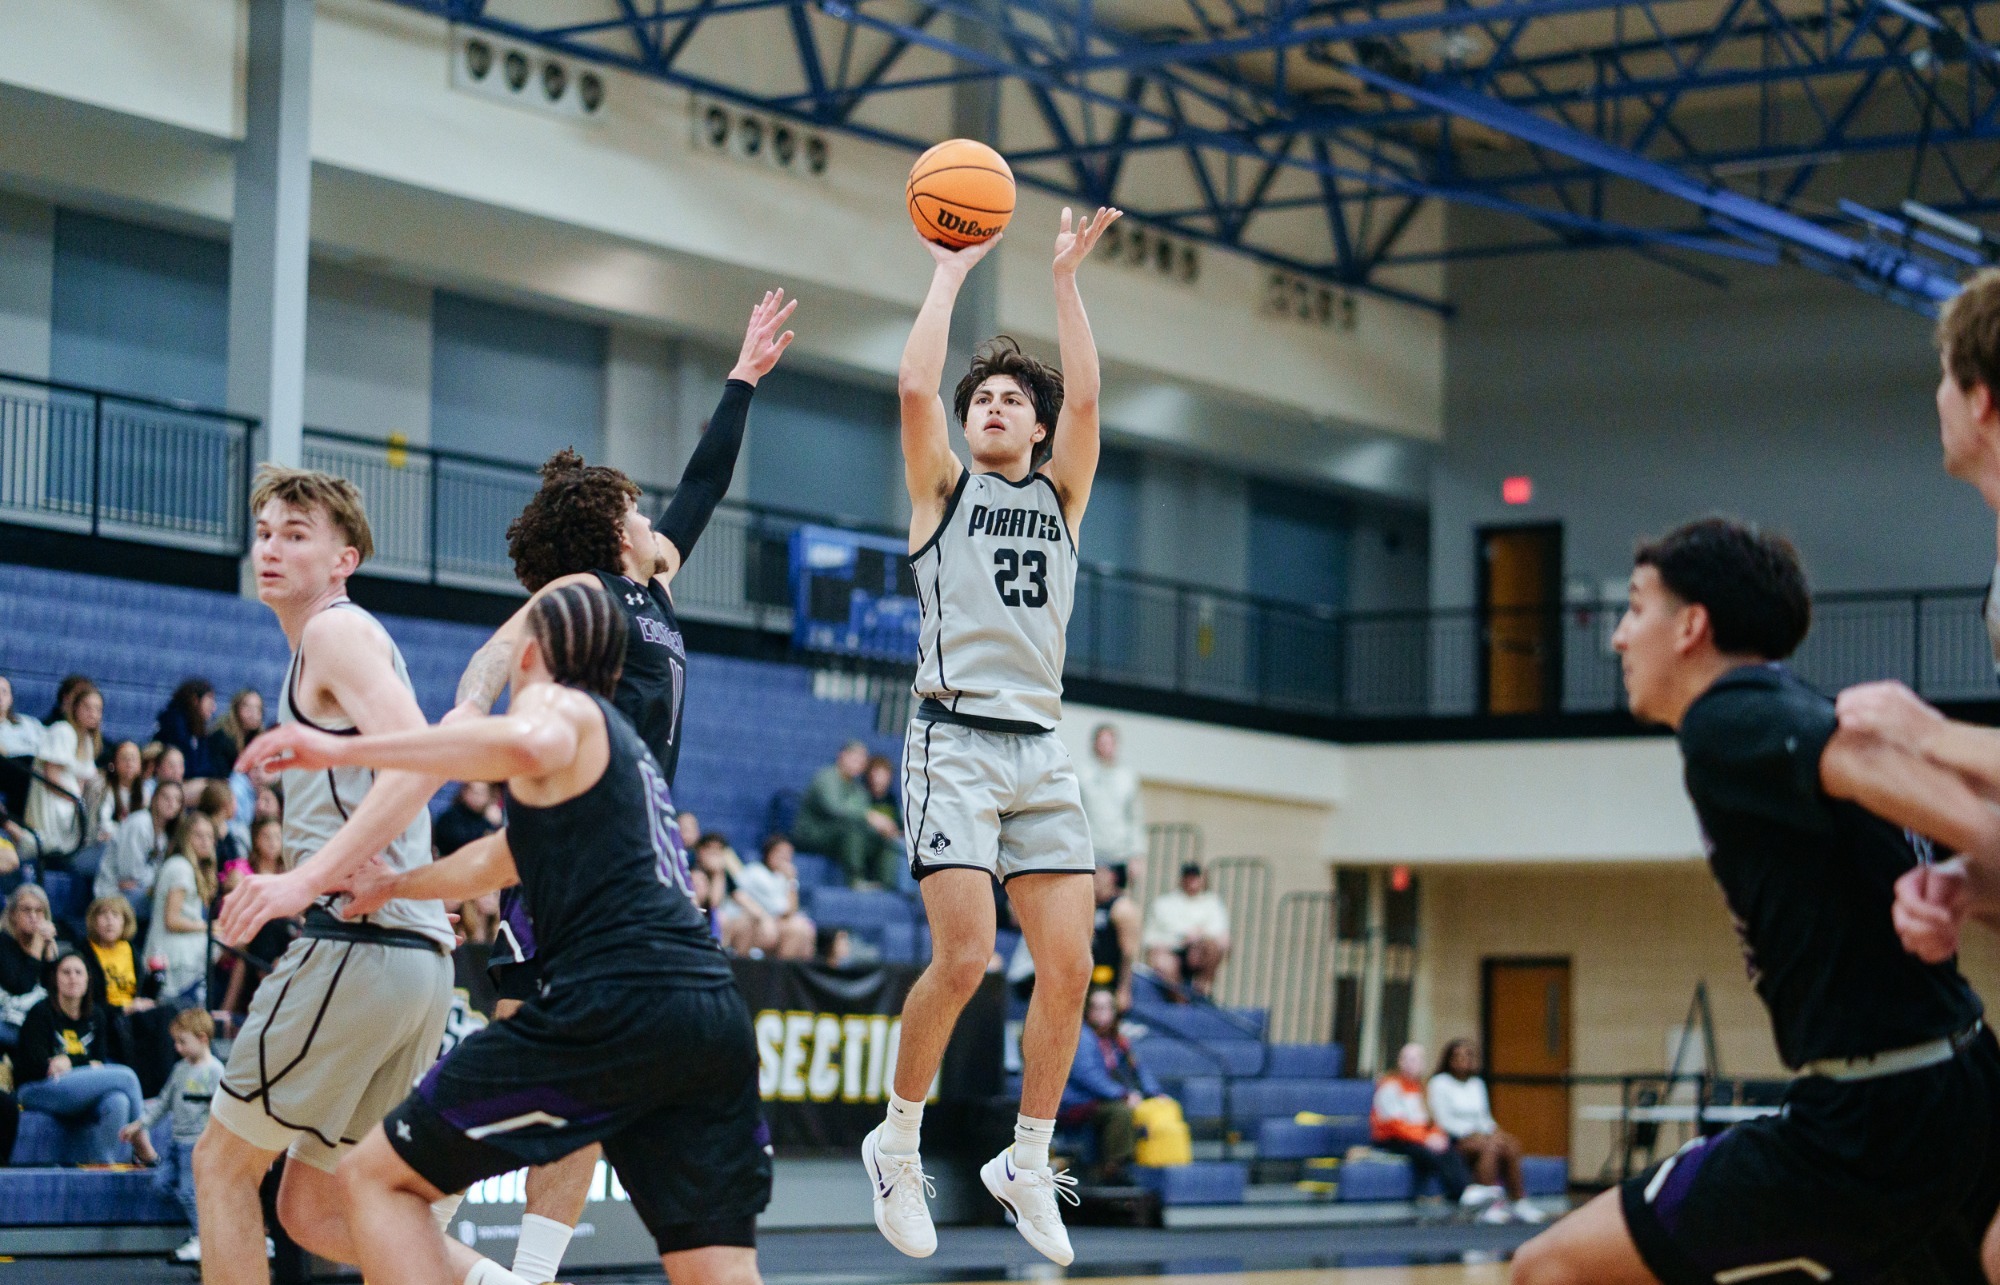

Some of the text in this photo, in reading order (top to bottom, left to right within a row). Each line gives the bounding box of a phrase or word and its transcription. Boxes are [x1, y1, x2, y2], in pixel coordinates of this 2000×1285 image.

[968, 504, 1061, 541] PIRATES
[994, 548, 1048, 608] 23
[755, 1009, 941, 1104] SECTI
